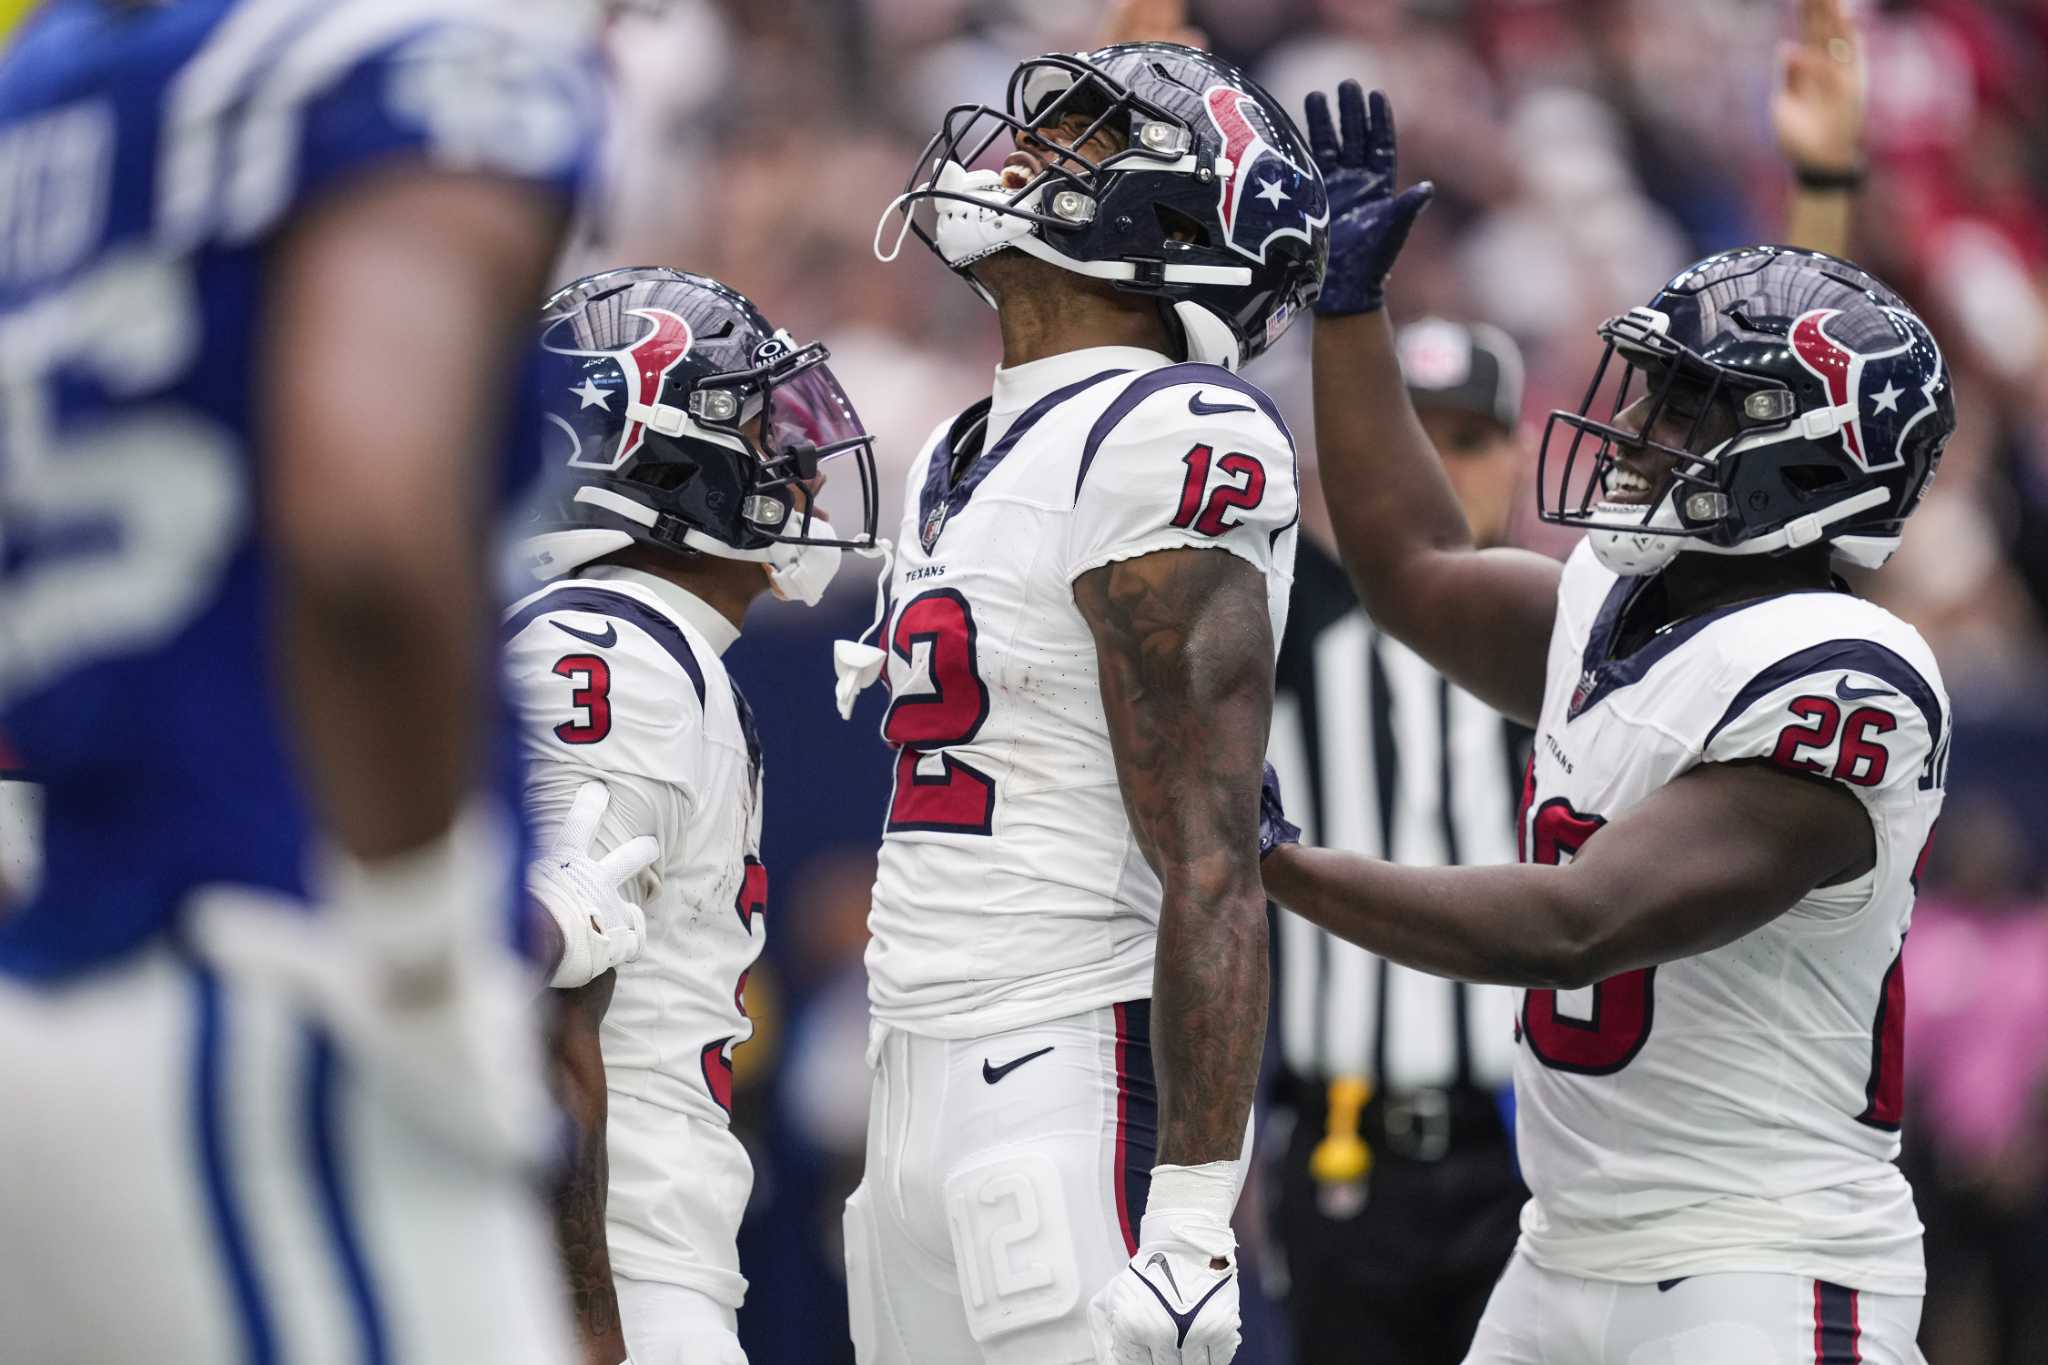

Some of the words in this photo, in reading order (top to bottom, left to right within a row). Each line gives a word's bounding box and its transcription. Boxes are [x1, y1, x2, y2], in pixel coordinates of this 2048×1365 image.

[1170, 443, 1266, 537] 12
[905, 565, 946, 583] TEXANS
[552, 653, 612, 744] 3
[880, 588, 995, 837] 2
[1774, 695, 1897, 787] 26
[951, 1172, 1054, 1309] 12
